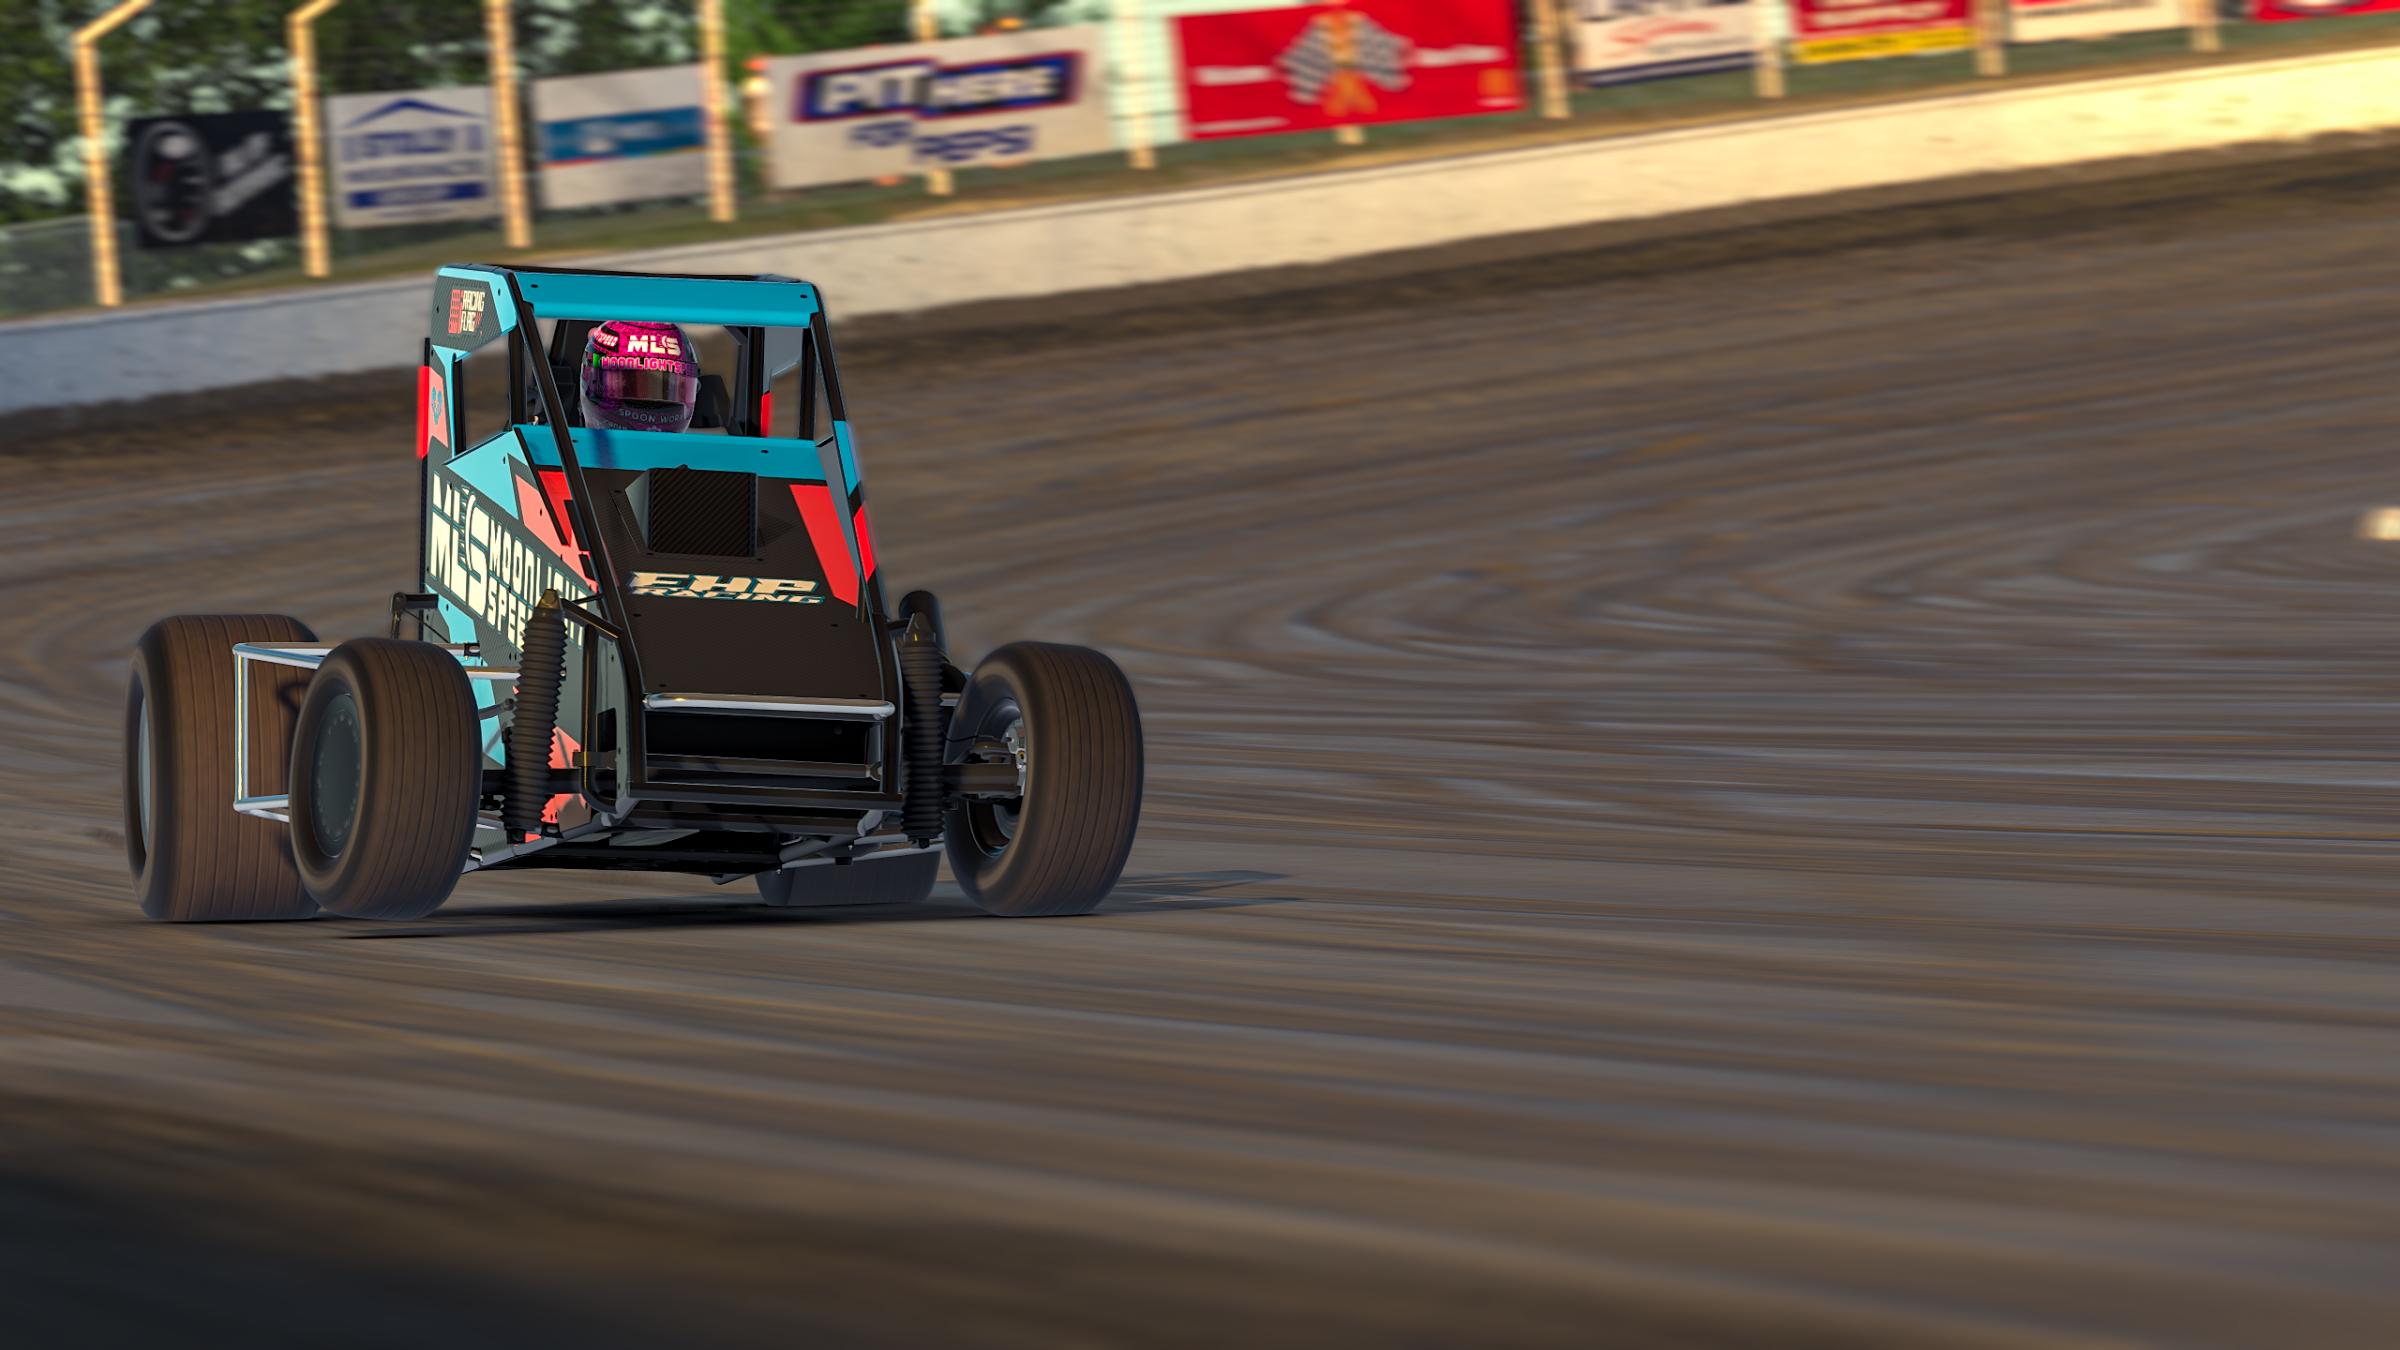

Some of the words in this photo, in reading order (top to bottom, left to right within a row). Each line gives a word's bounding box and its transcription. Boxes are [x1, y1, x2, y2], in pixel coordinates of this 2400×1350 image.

[462, 290, 486, 312] RACING
[627, 334, 681, 356] MLS
[619, 408, 656, 423] SPOON
[430, 473, 490, 617] MLS
[631, 587, 824, 604] RACING
[487, 576, 533, 652] SPEE
